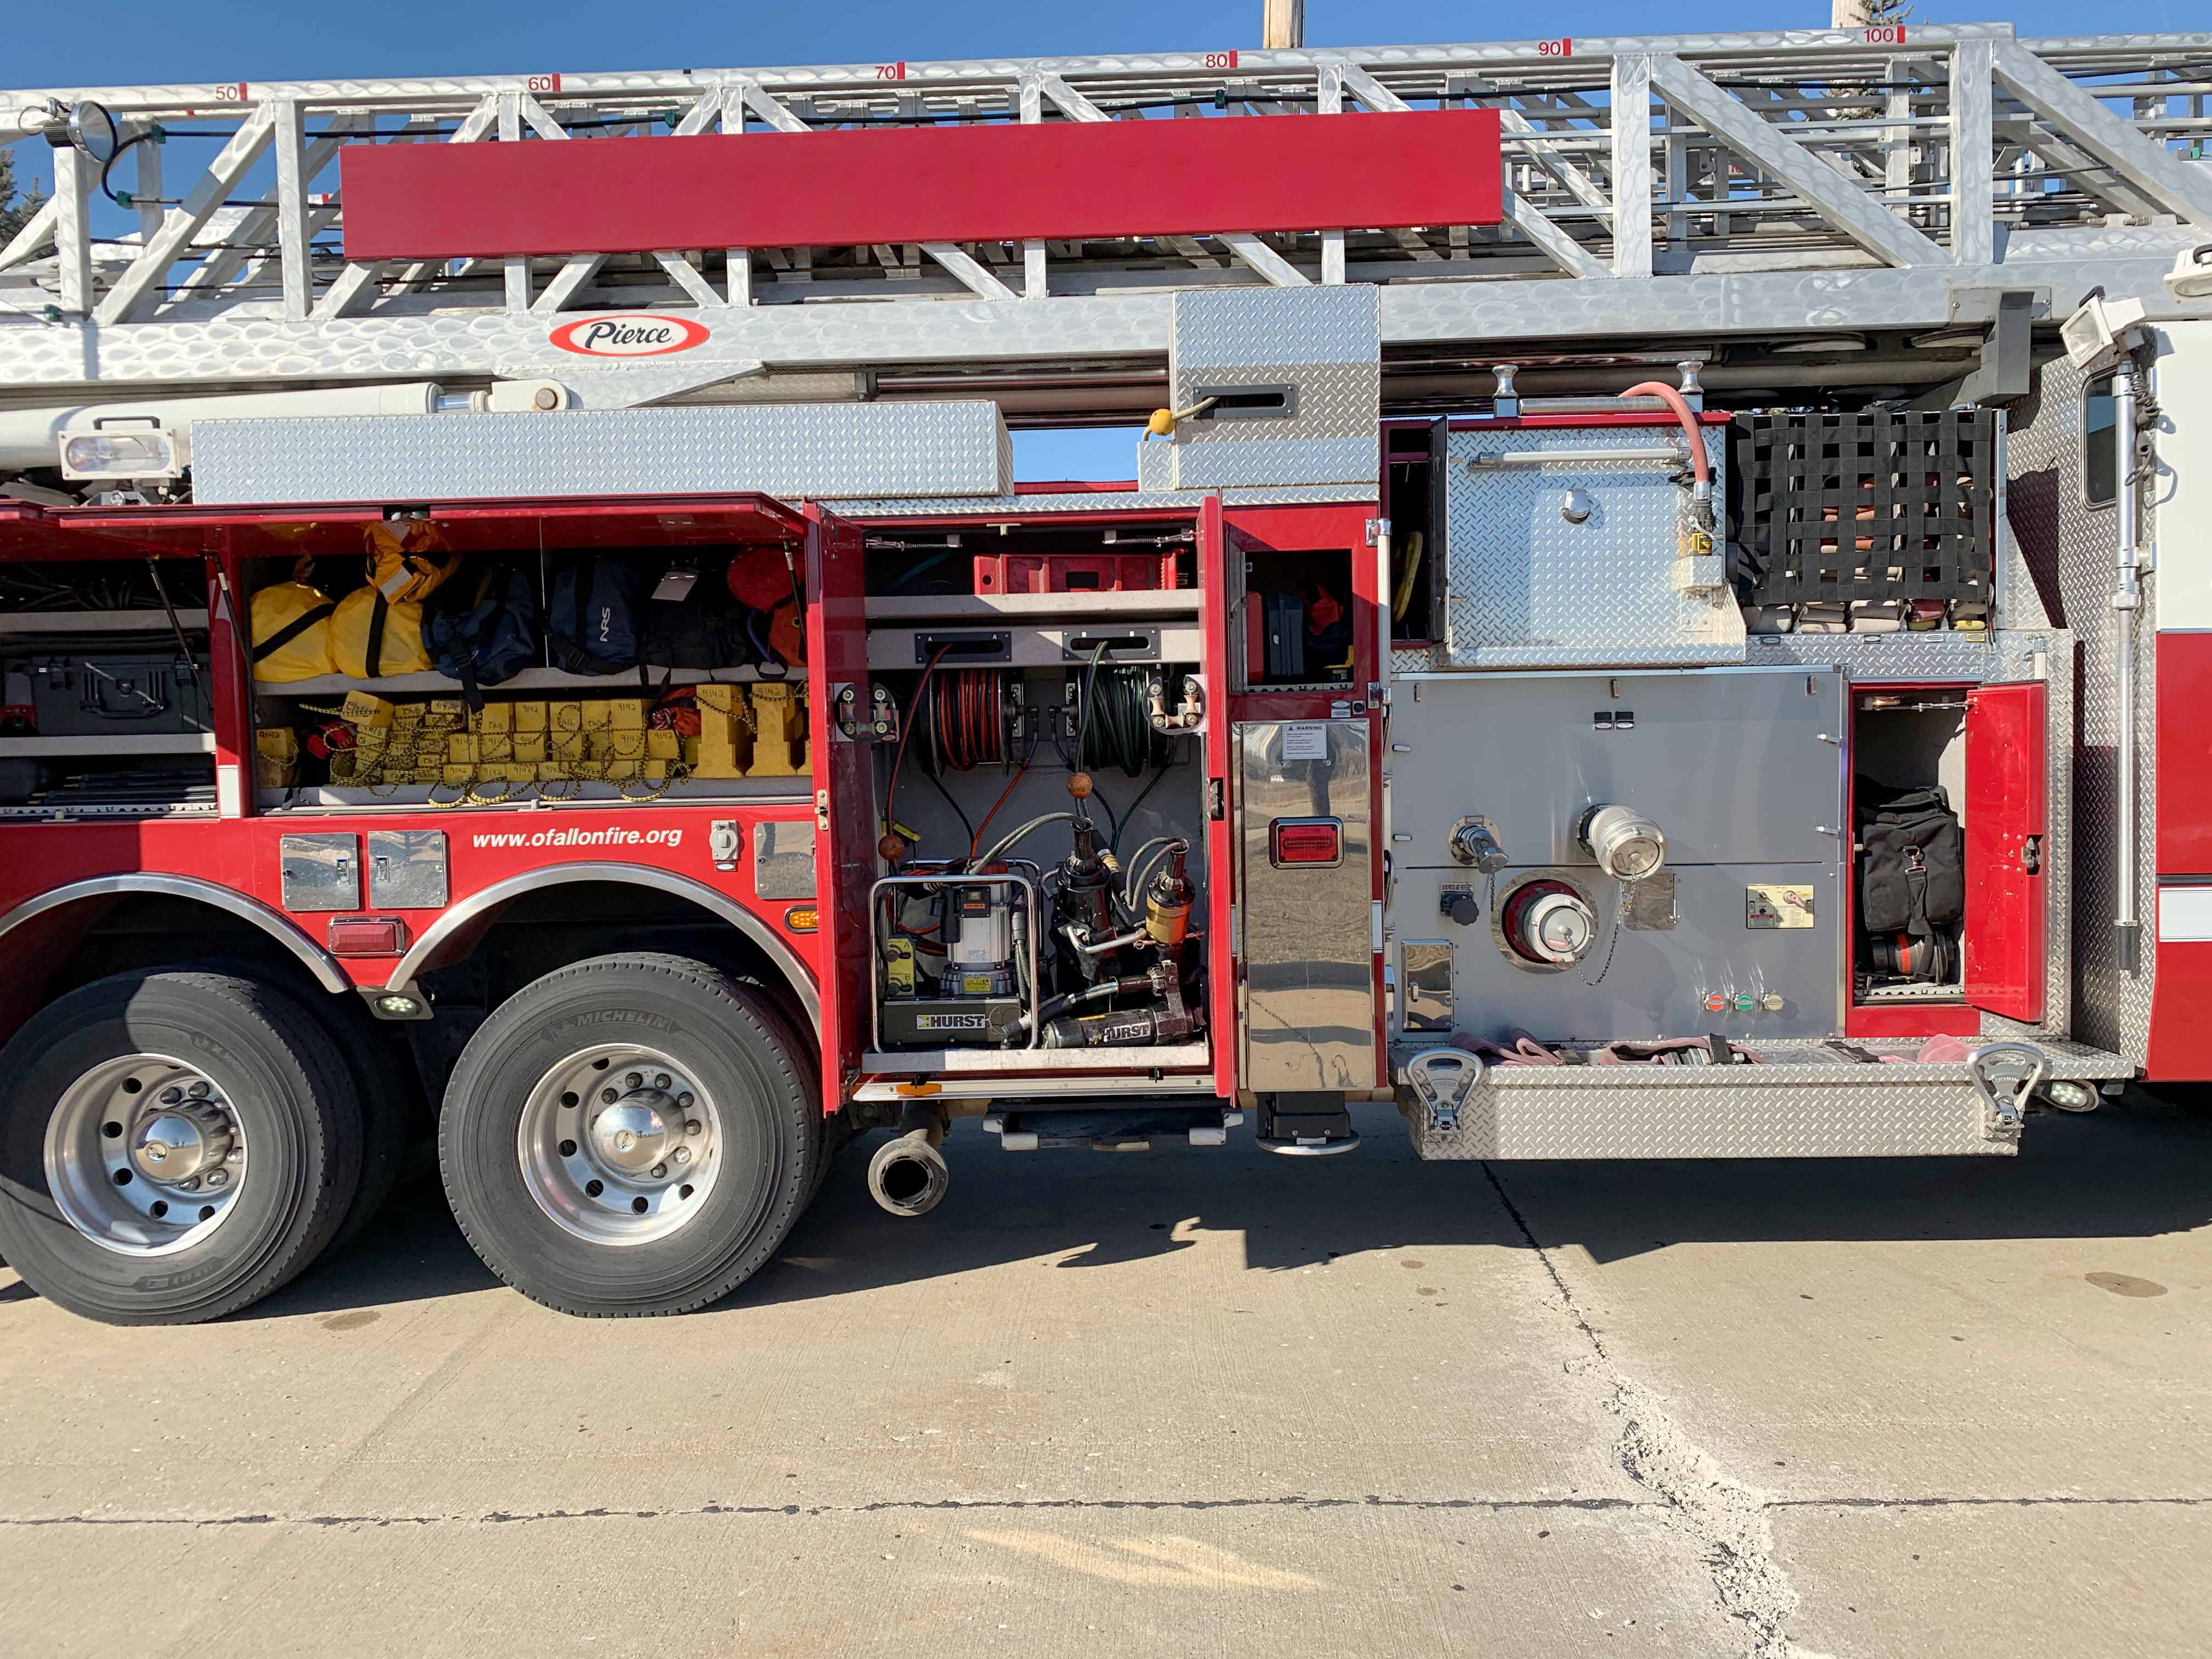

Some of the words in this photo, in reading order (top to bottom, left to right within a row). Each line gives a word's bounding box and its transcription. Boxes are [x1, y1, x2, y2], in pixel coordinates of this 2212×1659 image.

[1864, 29, 1893, 42] 100
[1538, 42, 1561, 55] 90
[1206, 54, 1227, 68] 80
[874, 66, 895, 80] 70
[528, 77, 551, 91] 60
[215, 86, 238, 100] 50
[585, 321, 672, 349] Pierce
[600, 606, 610, 642] NRS
[703, 689, 724, 698] 9142
[522, 704, 538, 713] 9142
[618, 703, 635, 711] 9142
[562, 718, 575, 726] 914
[473, 827, 682, 847] www.ofallonfire.org
[577, 1009, 668, 1028] MICHELIN
[930, 1015, 984, 1027] HURST
